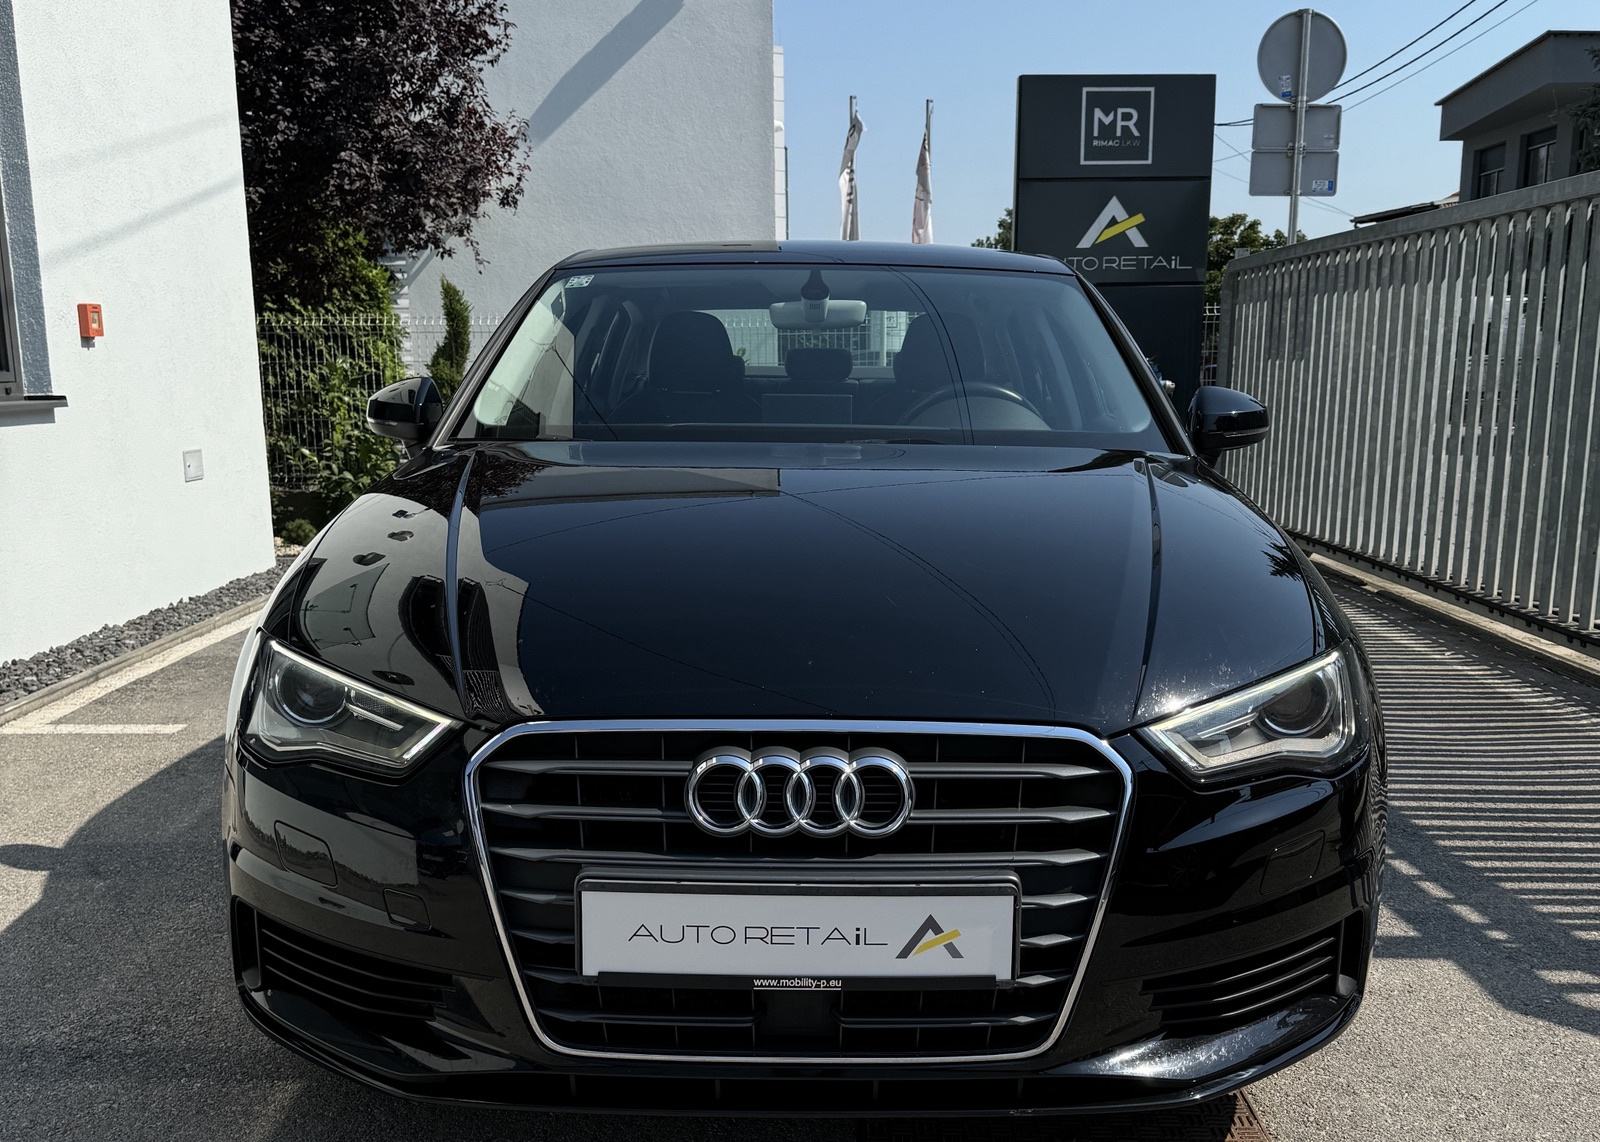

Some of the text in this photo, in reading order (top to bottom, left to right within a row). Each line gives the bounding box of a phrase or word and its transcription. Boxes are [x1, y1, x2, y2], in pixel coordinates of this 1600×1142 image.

[1093, 107, 1141, 137] MR
[1092, 139, 1120, 147] RIMAC
[1062, 256, 1099, 271] TO
[628, 923, 737, 946] AUTO
[753, 977, 842, 989] www.mobility-p.eu
